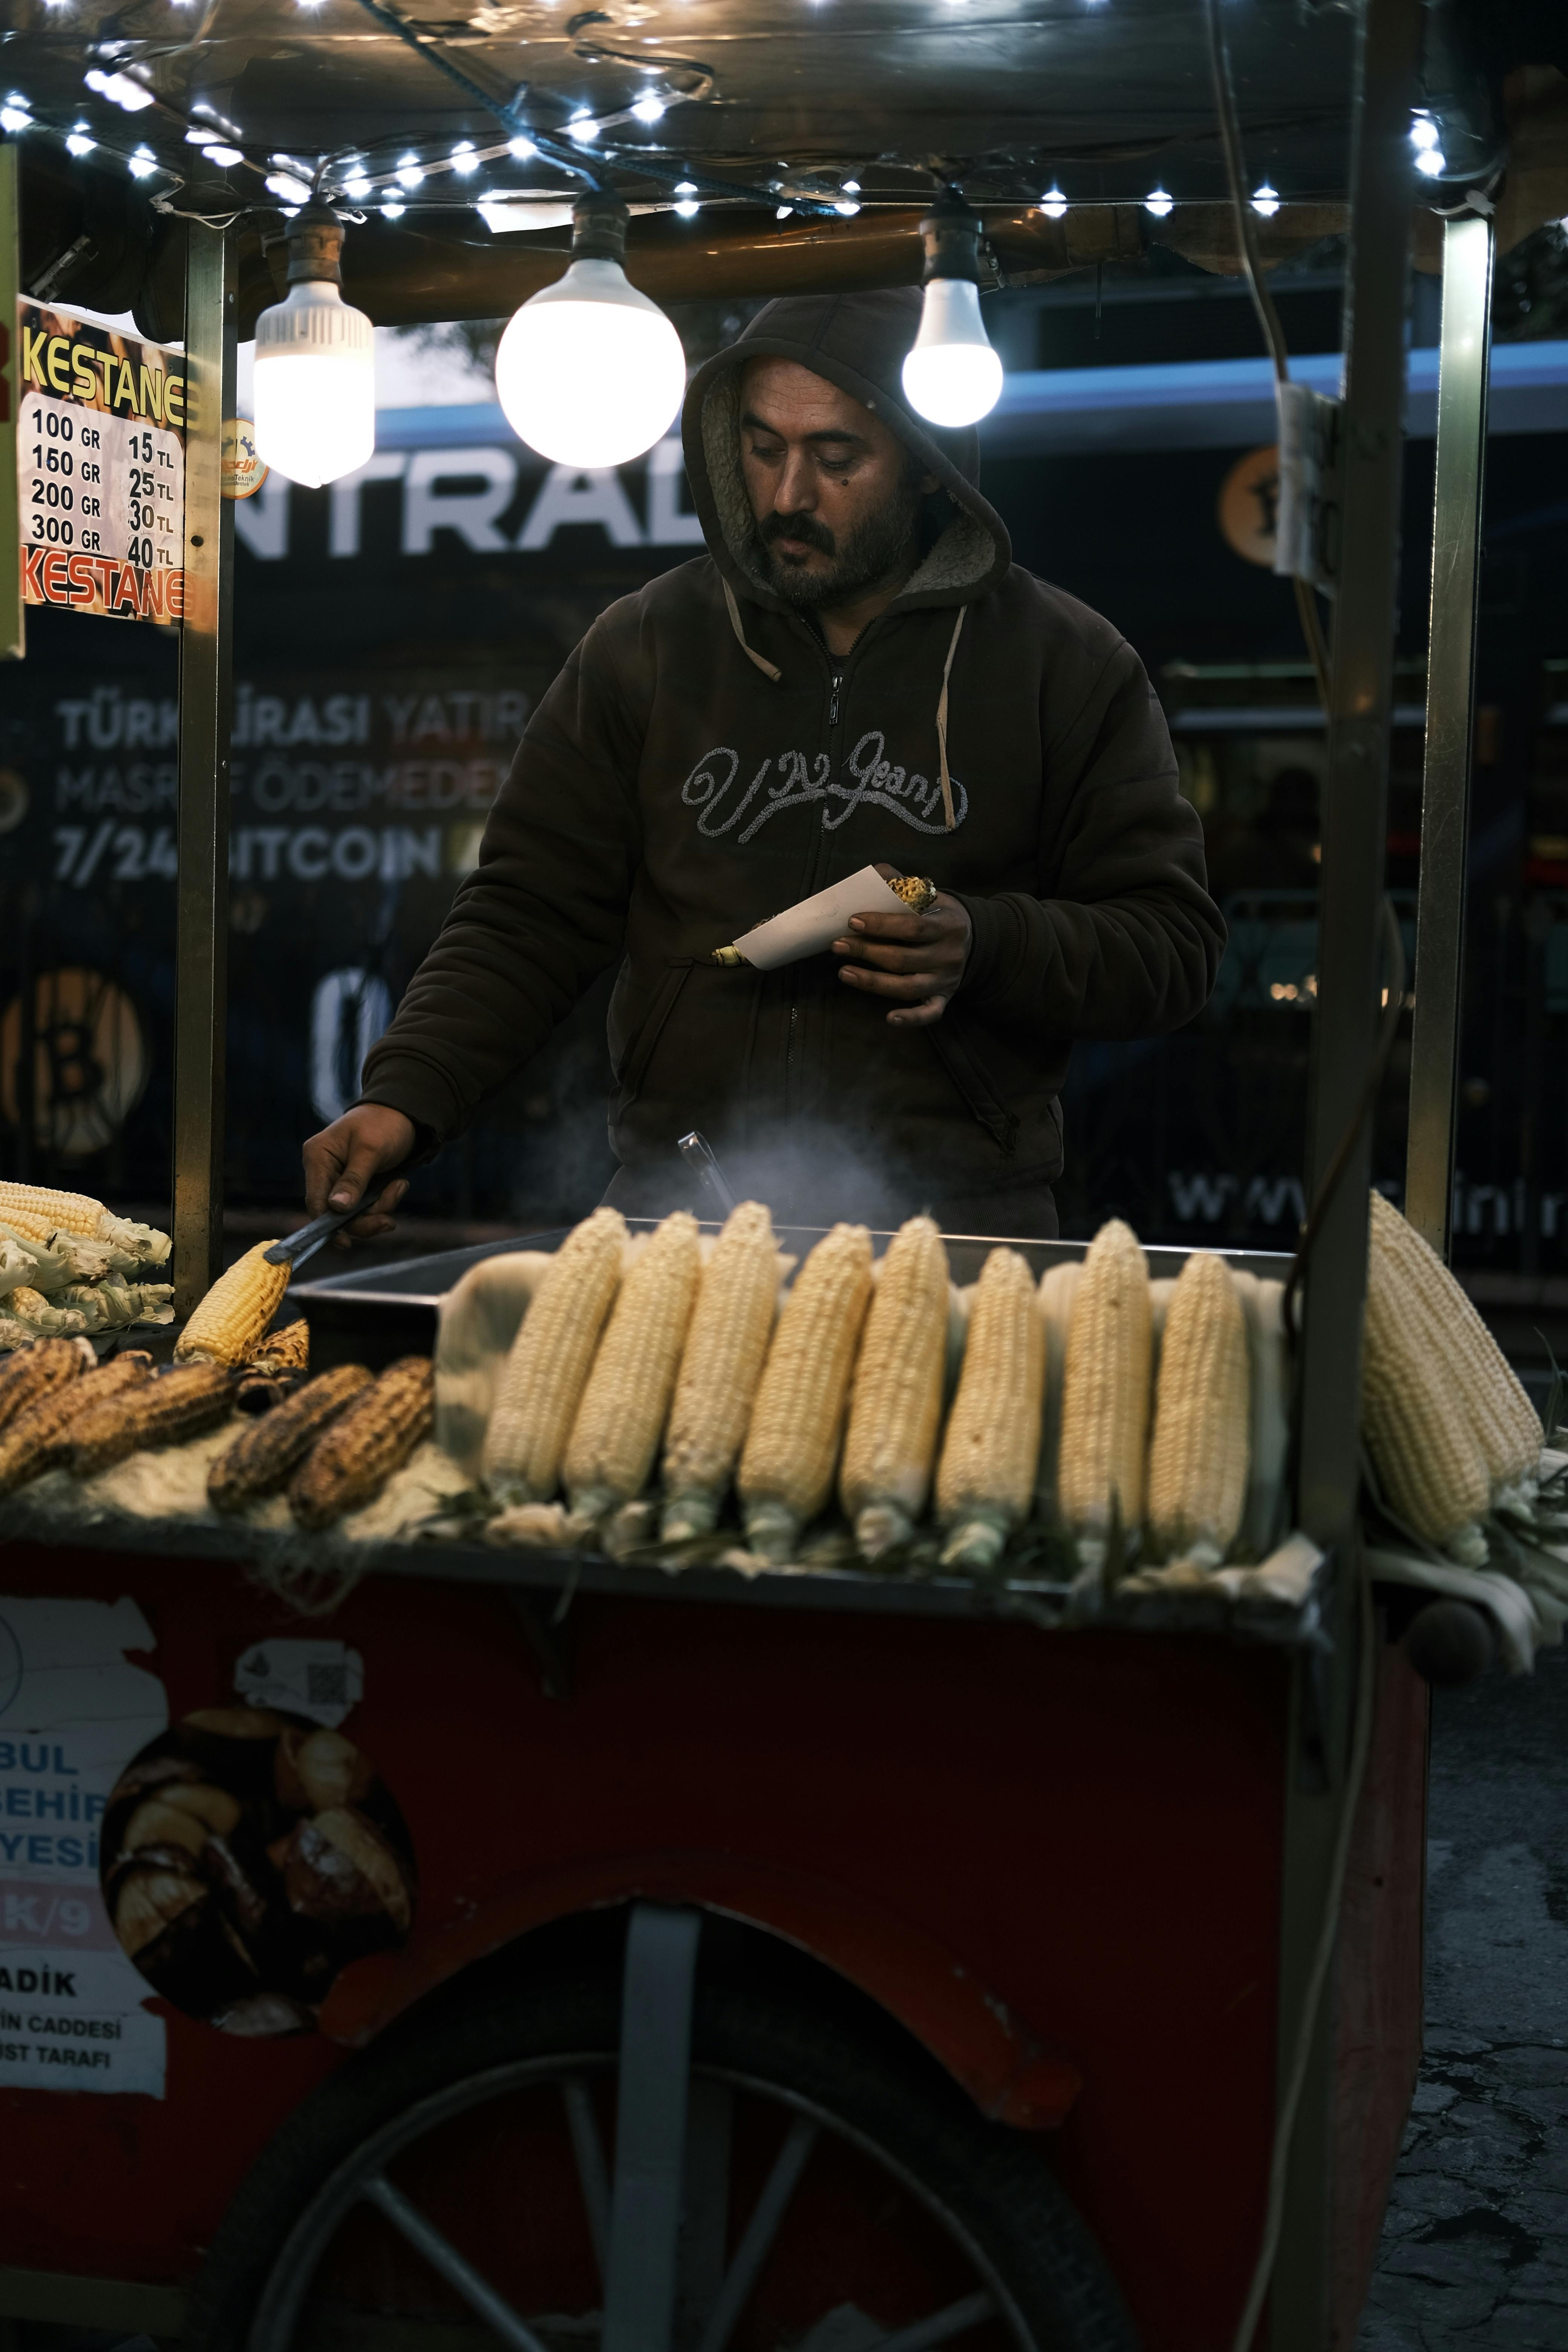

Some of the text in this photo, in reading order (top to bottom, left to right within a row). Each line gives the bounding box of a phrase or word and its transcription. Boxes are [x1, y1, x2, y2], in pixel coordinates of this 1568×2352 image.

[23, 326, 184, 426] KESTANE
[32, 409, 174, 469] 100 GR 15 TL
[33, 444, 174, 501] 150 GR 25 TL
[32, 479, 174, 533] 200 GR 30 TL
[32, 514, 173, 568] 300 GR 40 TL
[20, 544, 183, 617] KESTANE
[228, 825, 442, 881] ITCOIN
[28, 2015, 122, 2040] CADDESİ
[37, 2047, 110, 2070] TARAFI
